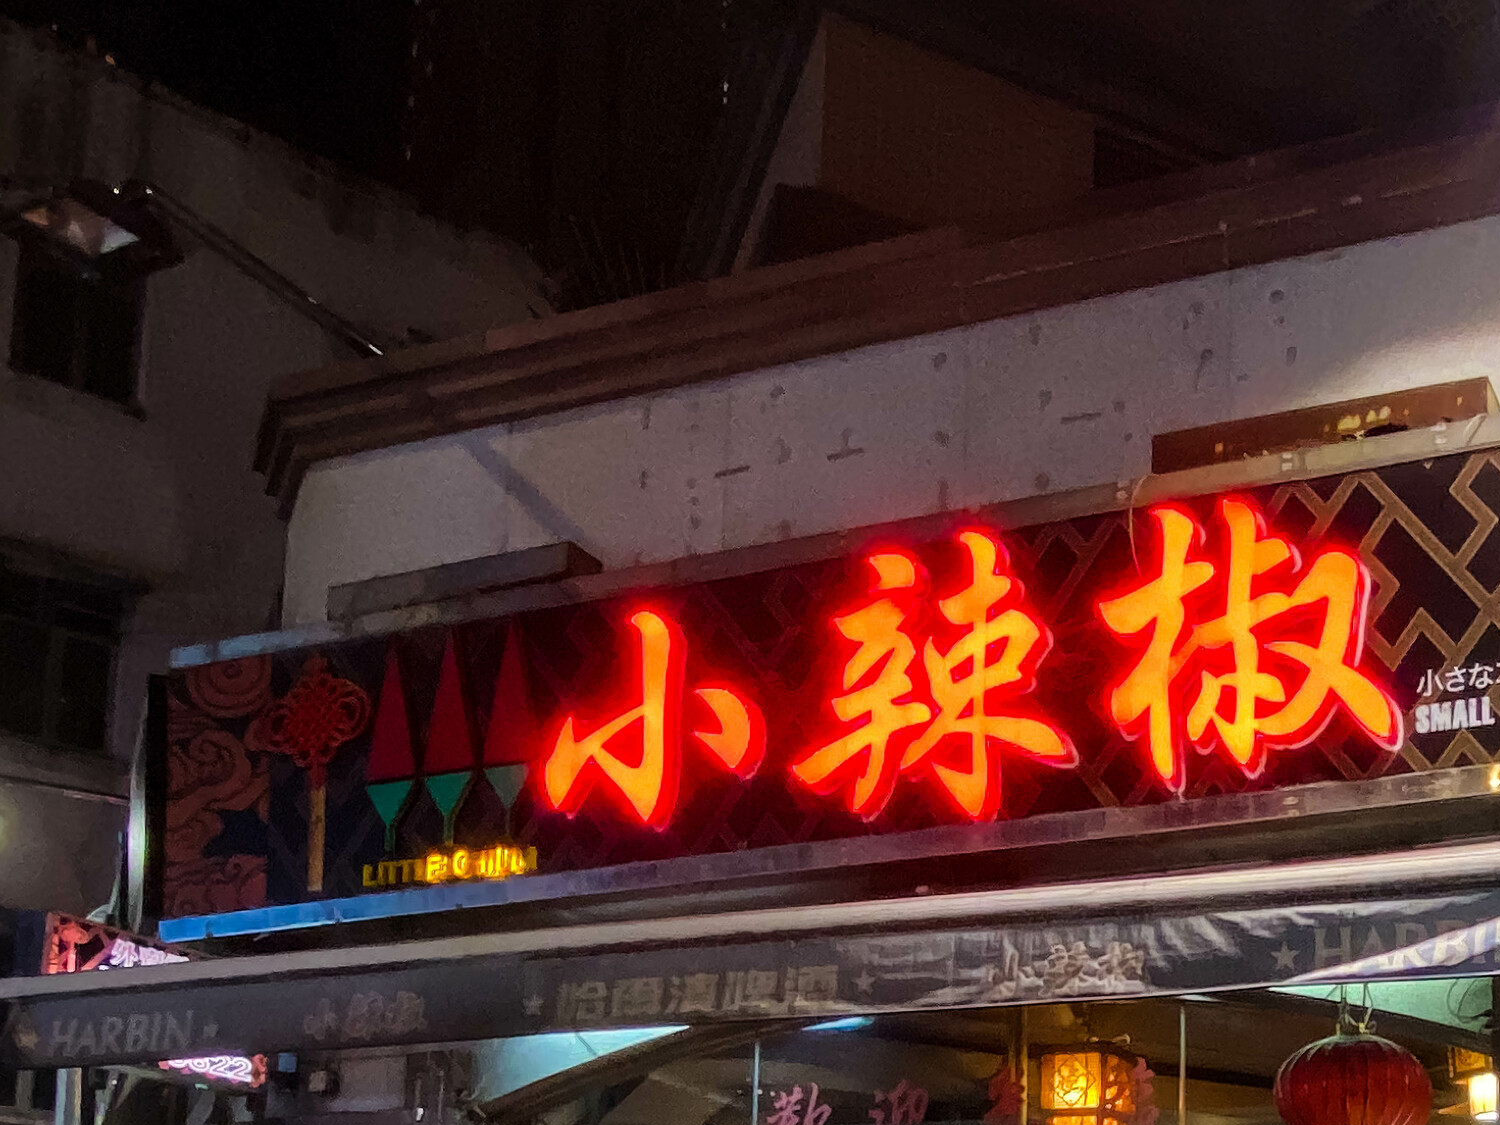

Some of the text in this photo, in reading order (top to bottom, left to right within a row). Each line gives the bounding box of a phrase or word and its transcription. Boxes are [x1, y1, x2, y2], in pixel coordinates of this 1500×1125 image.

[538, 497, 1403, 834] 小辣椒
[1414, 696, 1496, 734] SMALL
[48, 1010, 197, 1058] HARBIN
